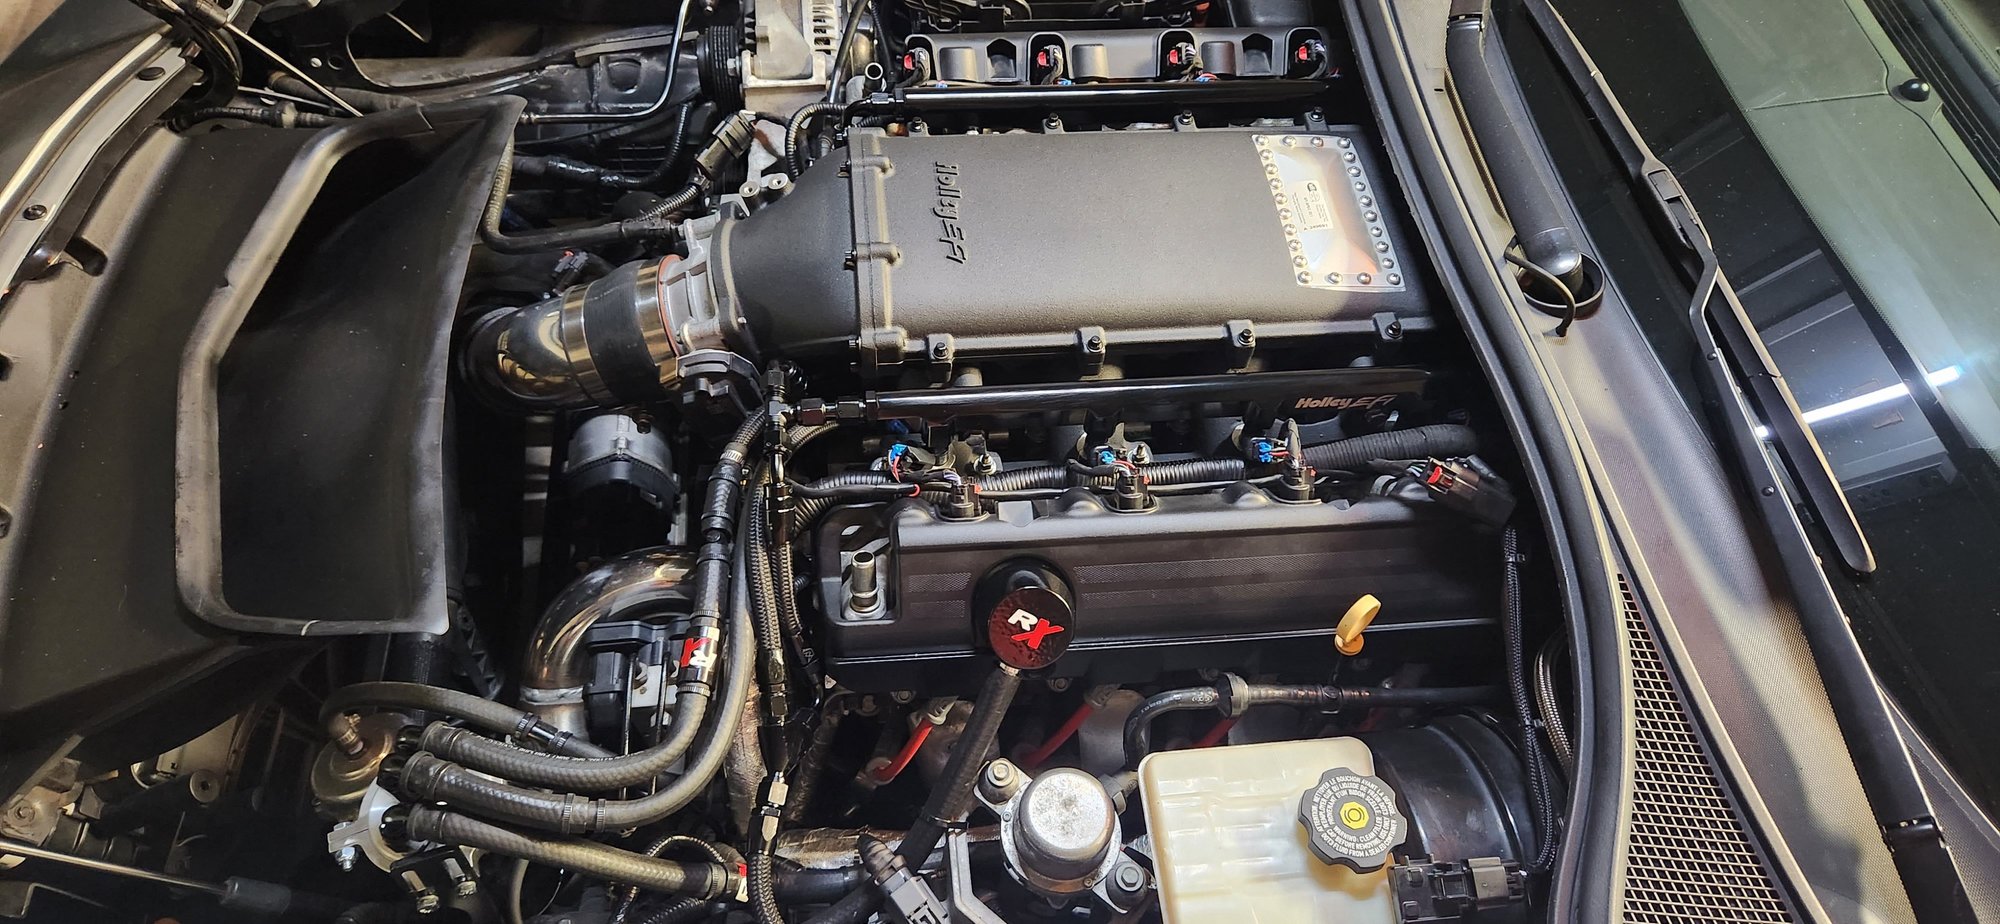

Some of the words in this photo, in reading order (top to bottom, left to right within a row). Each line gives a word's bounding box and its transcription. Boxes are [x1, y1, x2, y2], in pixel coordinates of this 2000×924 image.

[1295, 396, 1353, 410] Holley
[1349, 394, 1398, 409] EFI
[1007, 608, 1064, 650] RX
[1323, 789, 1334, 799] QUE
[1340, 781, 1359, 789] LIQUIDE
[1336, 775, 1361, 783] BOUCHON
[1361, 779, 1378, 791] AVANT
[1377, 788, 1384, 797] LA
[1335, 835, 1355, 850] BEFORE
[1378, 829, 1387, 840] USE
[1359, 831, 1377, 843] CLEAN
[1332, 842, 1349, 855] FLUID
[1349, 849, 1365, 857] FROM
[1369, 843, 1387, 856] SEALED
